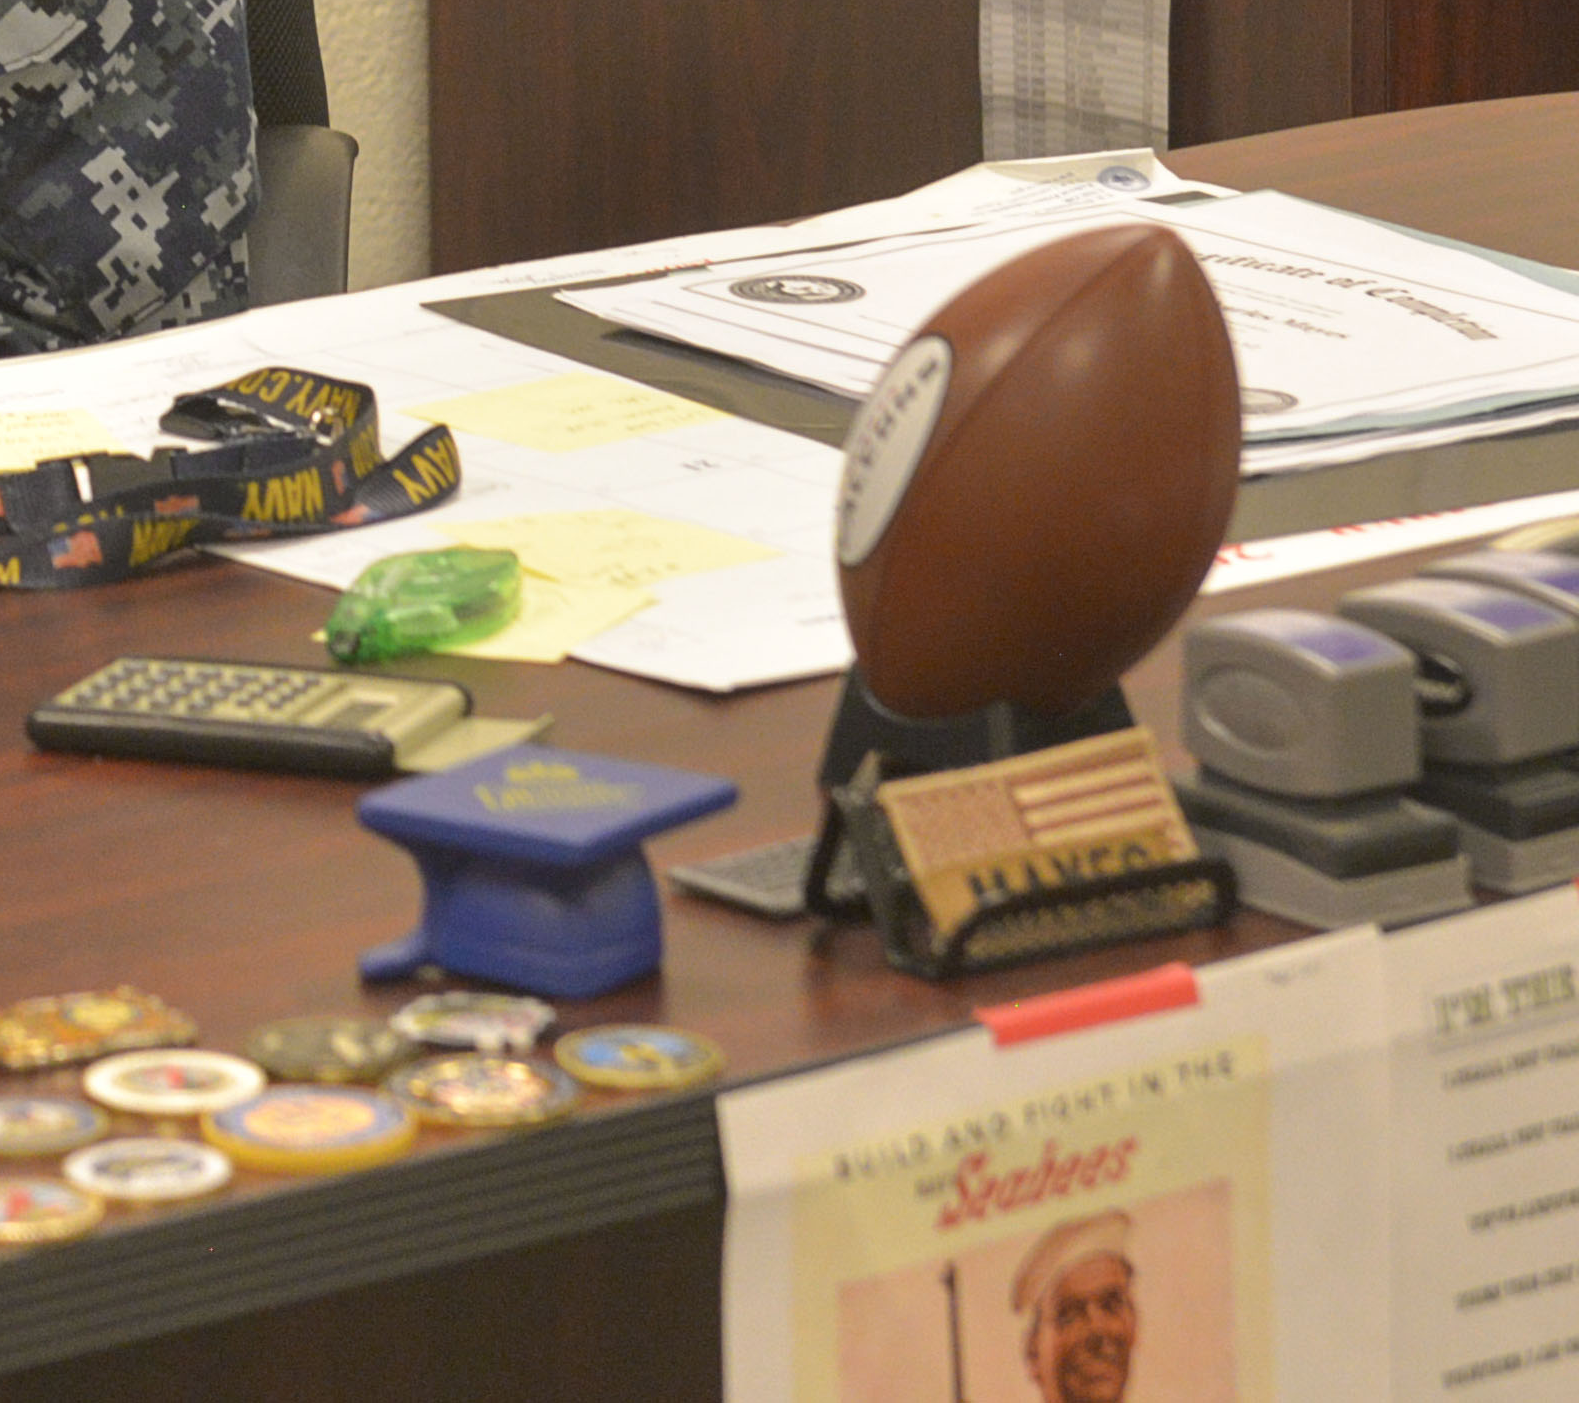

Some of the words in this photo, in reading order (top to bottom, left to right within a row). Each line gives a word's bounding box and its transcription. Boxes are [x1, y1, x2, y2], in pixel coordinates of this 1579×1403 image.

[240, 465, 325, 523] NAVY
[832, 1133, 929, 1181] BUILD
[945, 1110, 1011, 1147] AND
[1023, 1082, 1116, 1124] FIGHT
[1127, 1070, 1166, 1098] IN
[1177, 1050, 1235, 1086] THE
[934, 1135, 1141, 1232] Seabees
